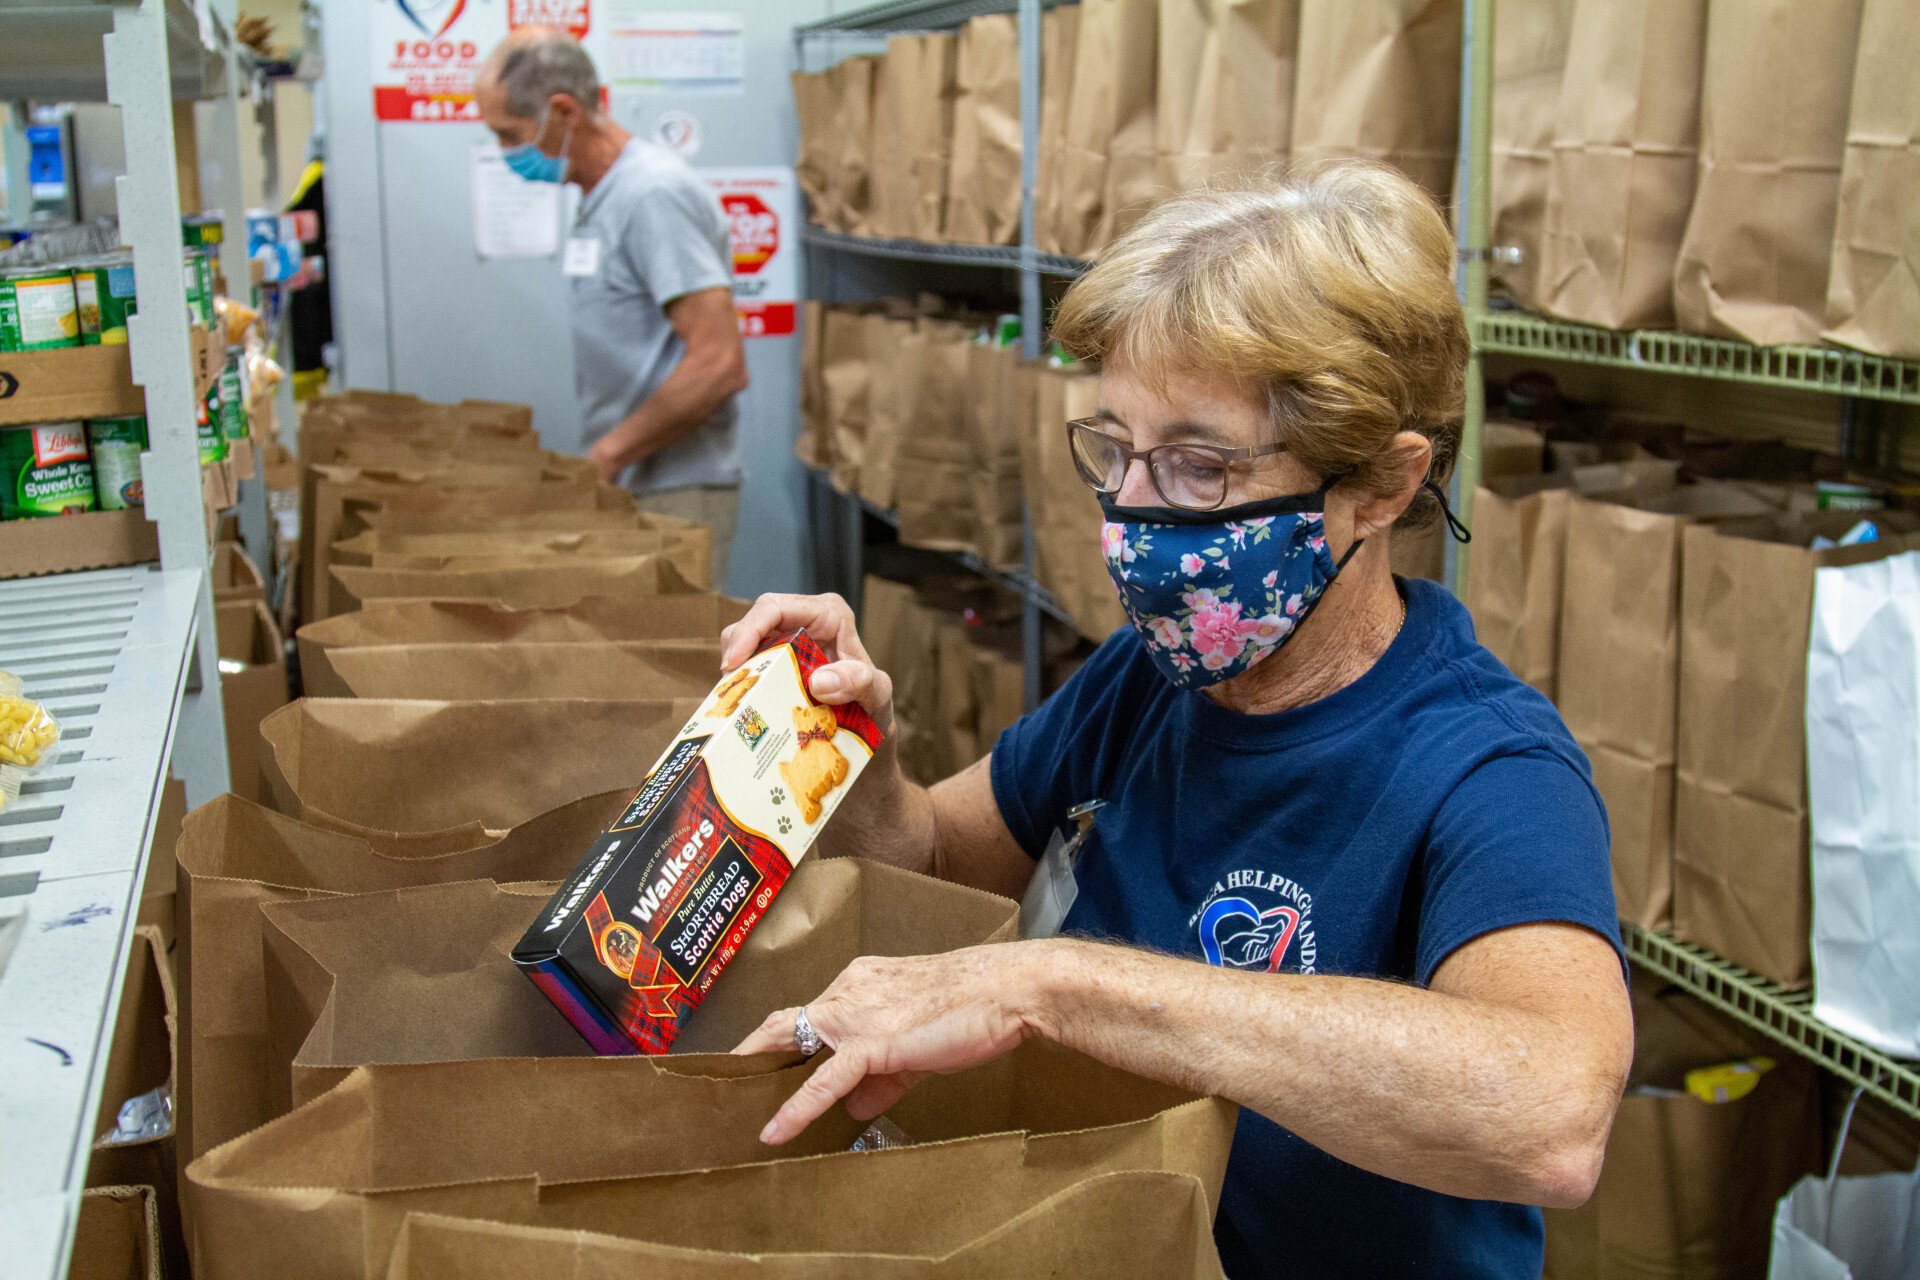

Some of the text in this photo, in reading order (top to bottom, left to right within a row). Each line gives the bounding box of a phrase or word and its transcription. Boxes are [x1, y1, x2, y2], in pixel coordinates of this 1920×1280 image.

[396, 41, 477, 59] FOOD
[25, 478, 74, 498] Sweet
[31, 465, 68, 481] Whole
[624, 742, 692, 824] SHORTBREAD
[633, 763, 669, 805] Pure Butter
[639, 744, 701, 816] Scottie Dogs
[630, 818, 714, 924] Walkers
[637, 825, 691, 892] PRODUCT OF SCOTLAND
[543, 840, 621, 932] Walkers
[662, 868, 695, 914] ESTABLISHED
[670, 861, 740, 956] SHORTBREAD
[677, 870, 716, 923] Pure Butter
[1227, 870, 1312, 911] HELPING
[684, 876, 750, 966] Scottie Dogs
[700, 977, 713, 994] Net
[710, 963, 722, 977] Wt
[720, 945, 736, 965] 110g
